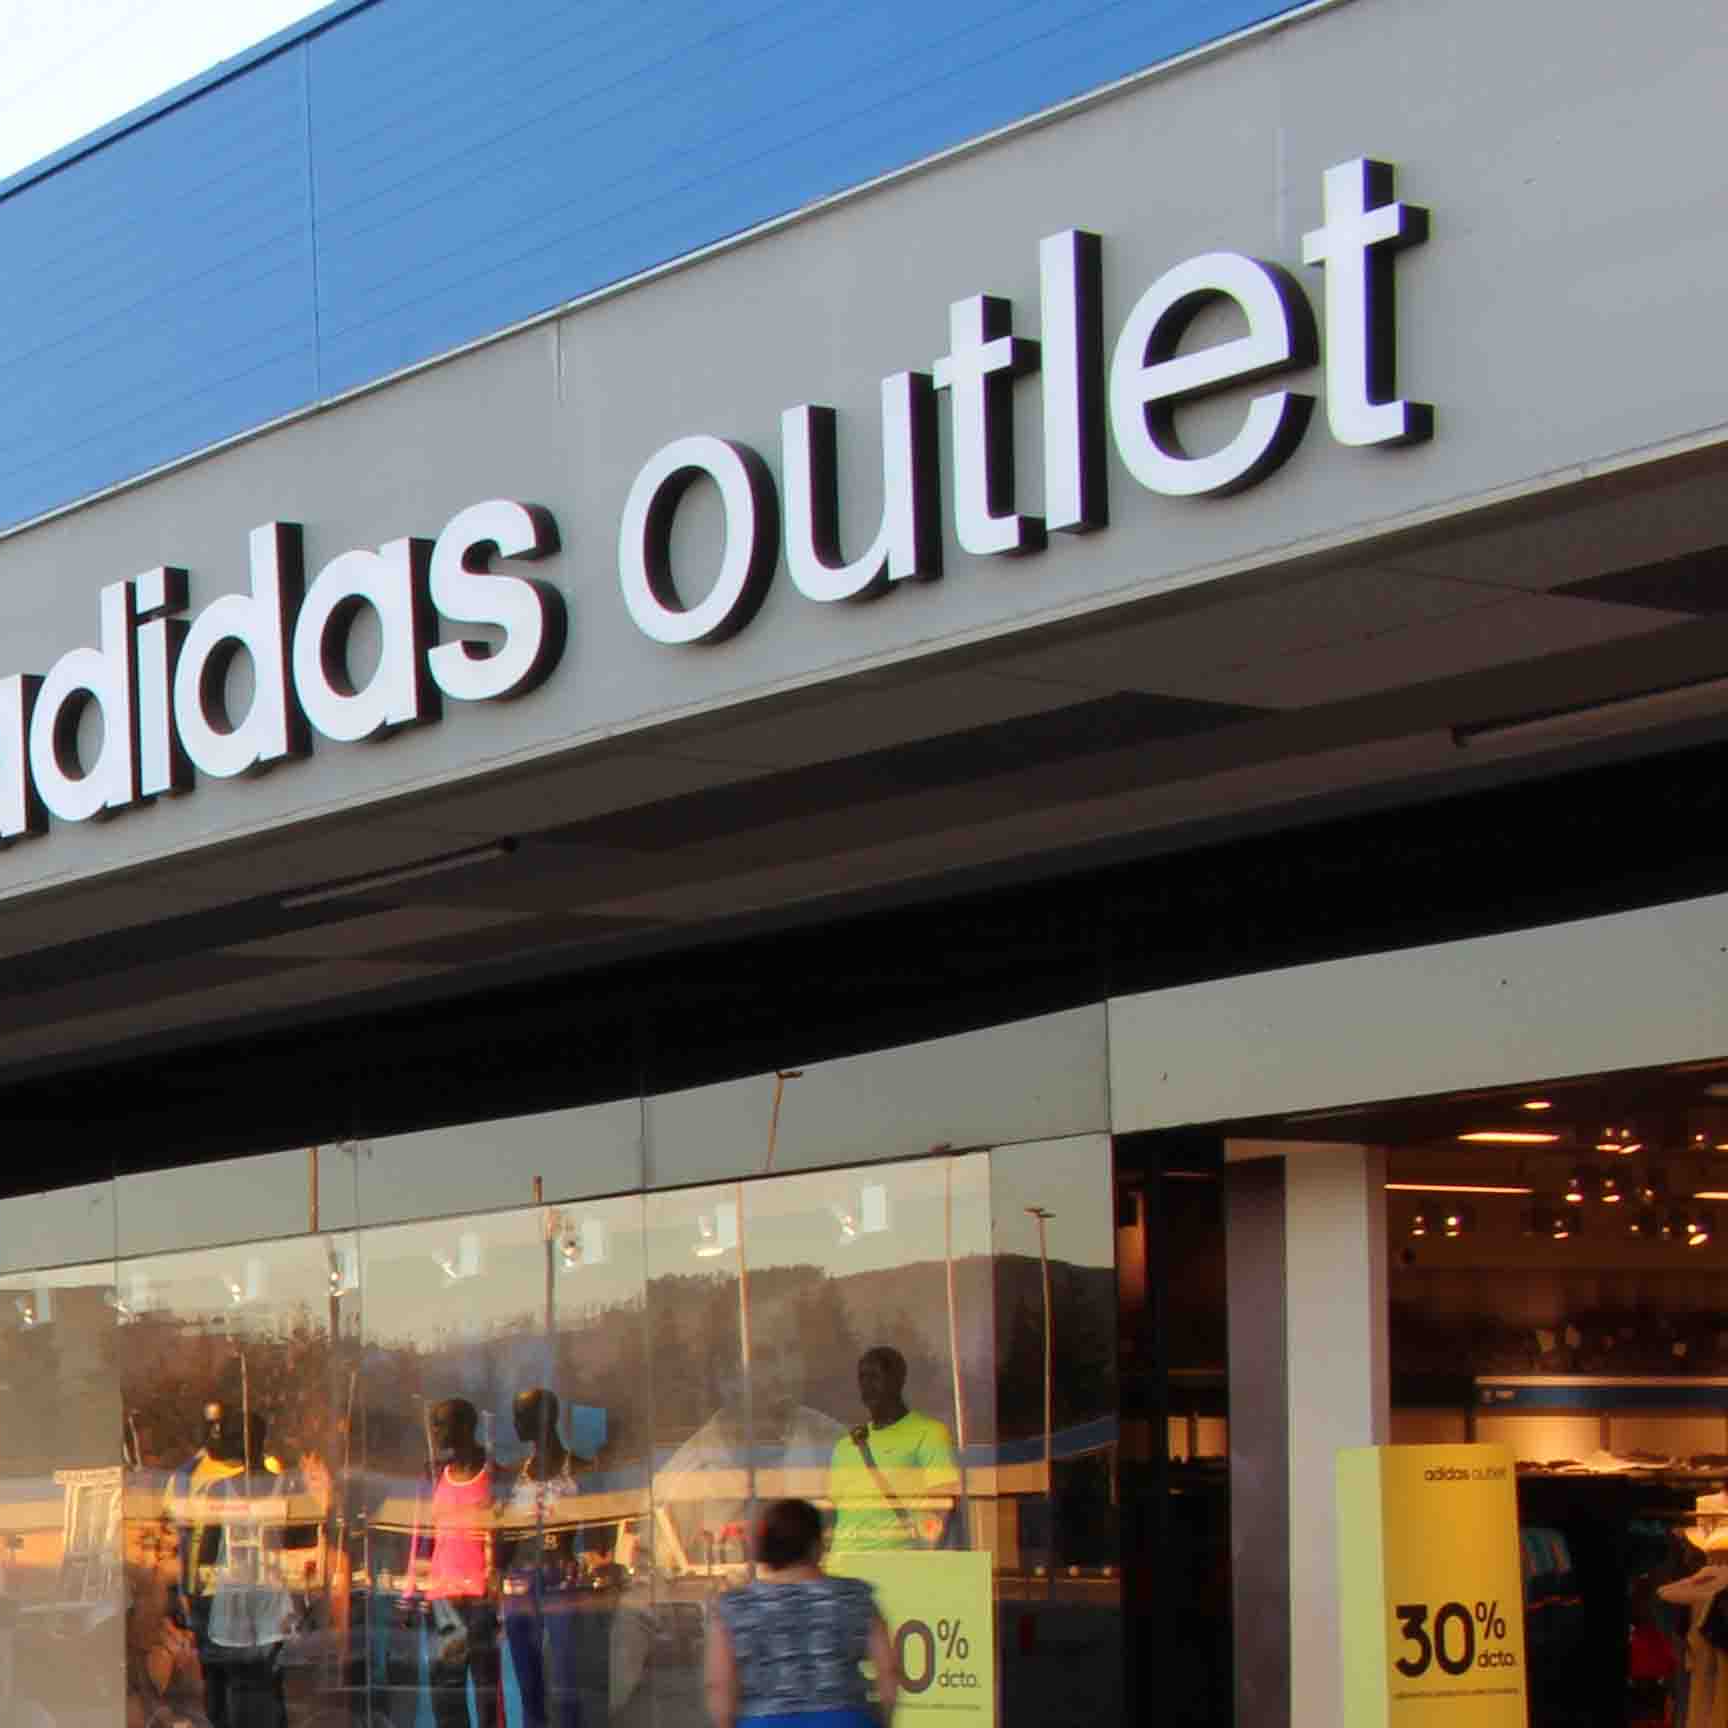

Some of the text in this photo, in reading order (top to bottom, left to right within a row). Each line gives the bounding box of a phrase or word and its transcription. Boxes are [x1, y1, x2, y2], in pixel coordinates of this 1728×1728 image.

[617, 157, 1433, 645] outlet
[1424, 1466, 1470, 1480] adidas
[894, 1618, 969, 1694] 0%
[1395, 1601, 1506, 1678] 30%
